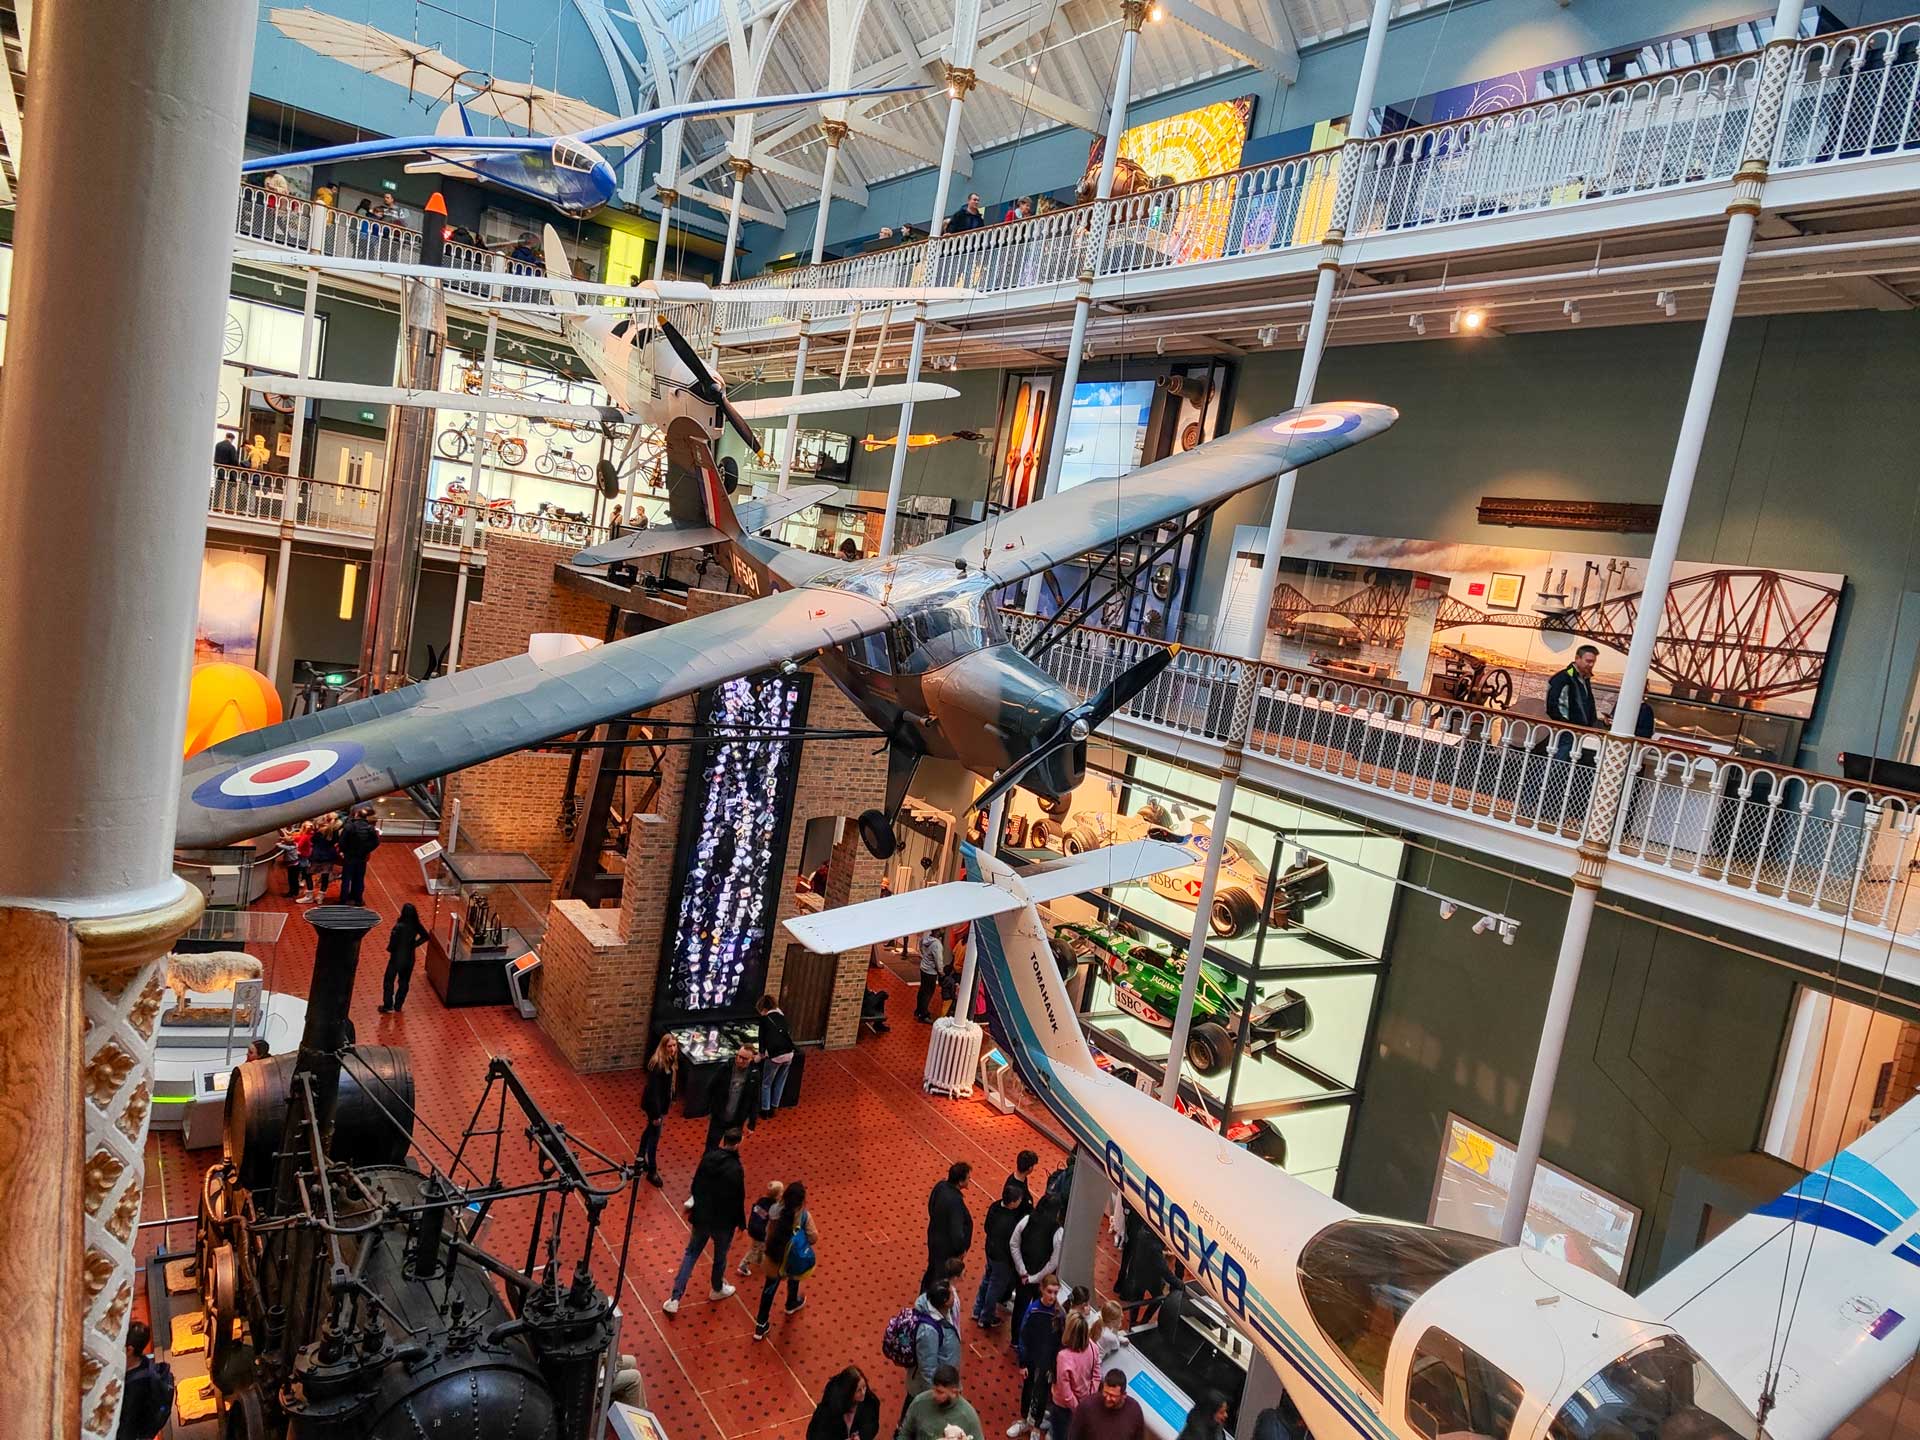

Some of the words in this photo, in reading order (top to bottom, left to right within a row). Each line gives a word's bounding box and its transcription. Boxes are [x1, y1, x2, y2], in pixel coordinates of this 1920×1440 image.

[1030, 951, 1059, 1034] TOMAHAWK
[1150, 974, 1176, 992] JAGUAR
[1105, 1139, 1248, 1322] G-BGXB
[1192, 1200, 1215, 1227] PIPER
[1216, 1220, 1262, 1269] TOMAHAWK
